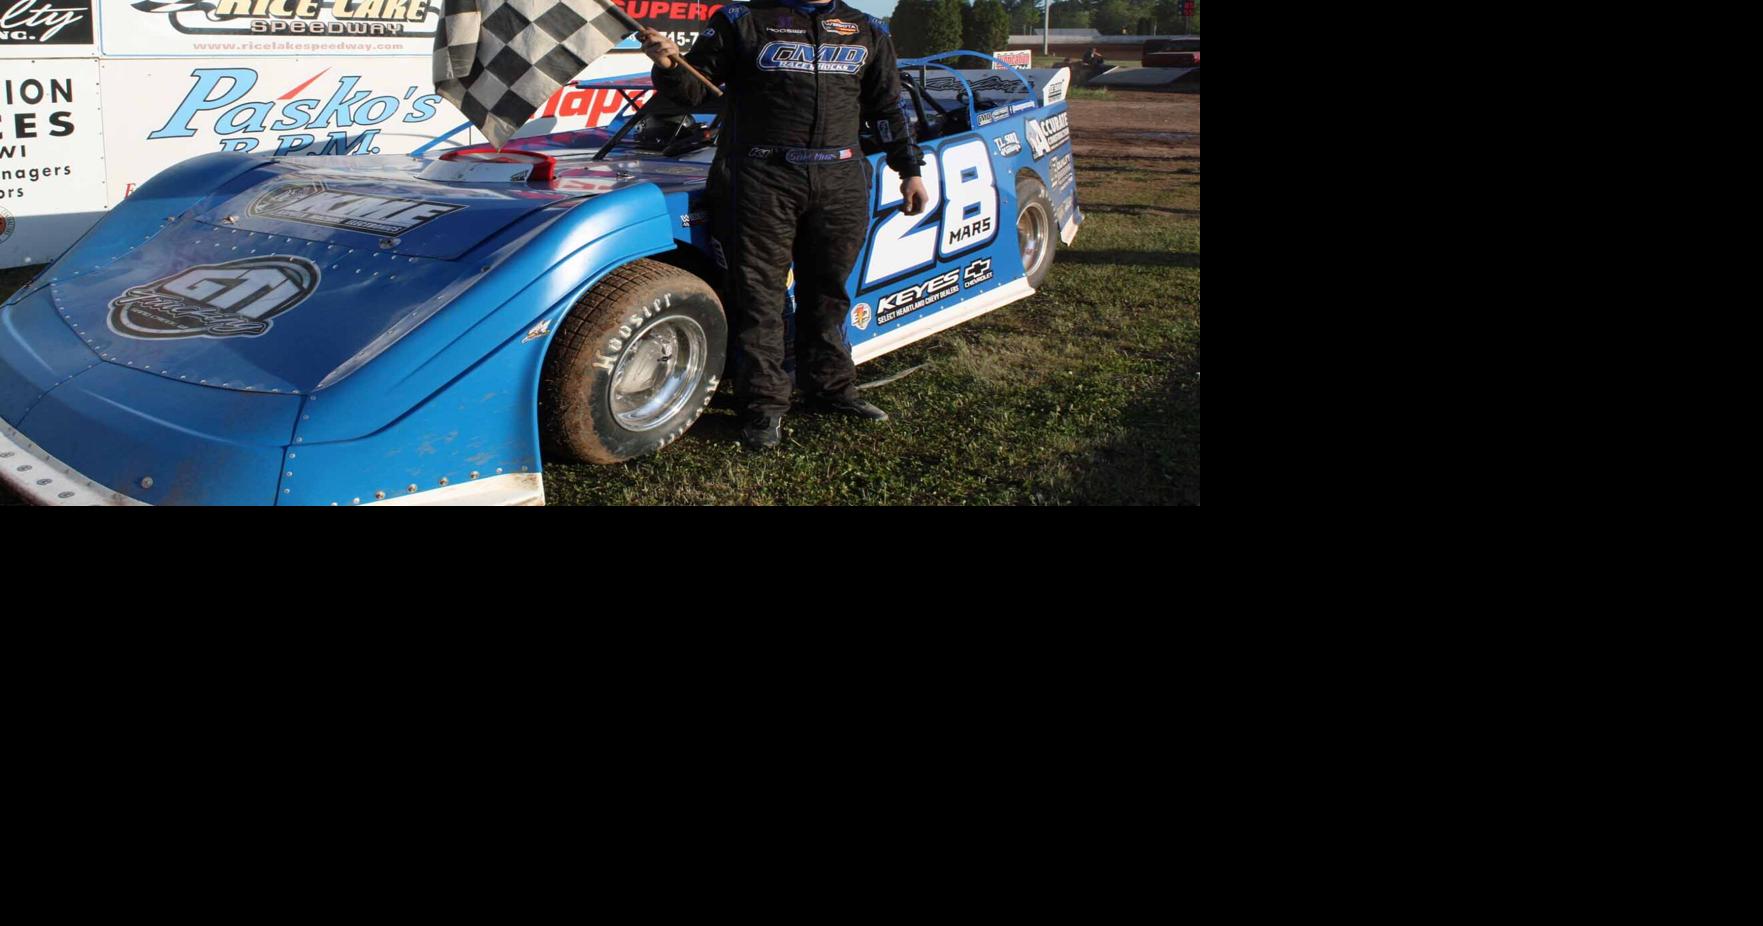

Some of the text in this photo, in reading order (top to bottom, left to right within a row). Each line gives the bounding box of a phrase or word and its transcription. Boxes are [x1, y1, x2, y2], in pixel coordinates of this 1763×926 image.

[332, 0, 428, 22] LAKE
[193, 42, 404, 51] www.ricelakespeedway.com
[759, 42, 867, 66] CMD
[5, 78, 73, 104] ION
[147, 67, 443, 140] Pasko's
[0, 111, 75, 140] ES
[2, 165, 71, 182] nagers
[860, 136, 998, 290] 28
[949, 217, 991, 245] MARS
[877, 268, 993, 314] KEYES CHEVROLET
[877, 311, 896, 325] SELECT
[896, 301, 926, 317] HEARTLAND
[925, 294, 940, 307] CHEVY
[940, 285, 960, 300] DEALERS
[592, 292, 672, 376] Hoosier
